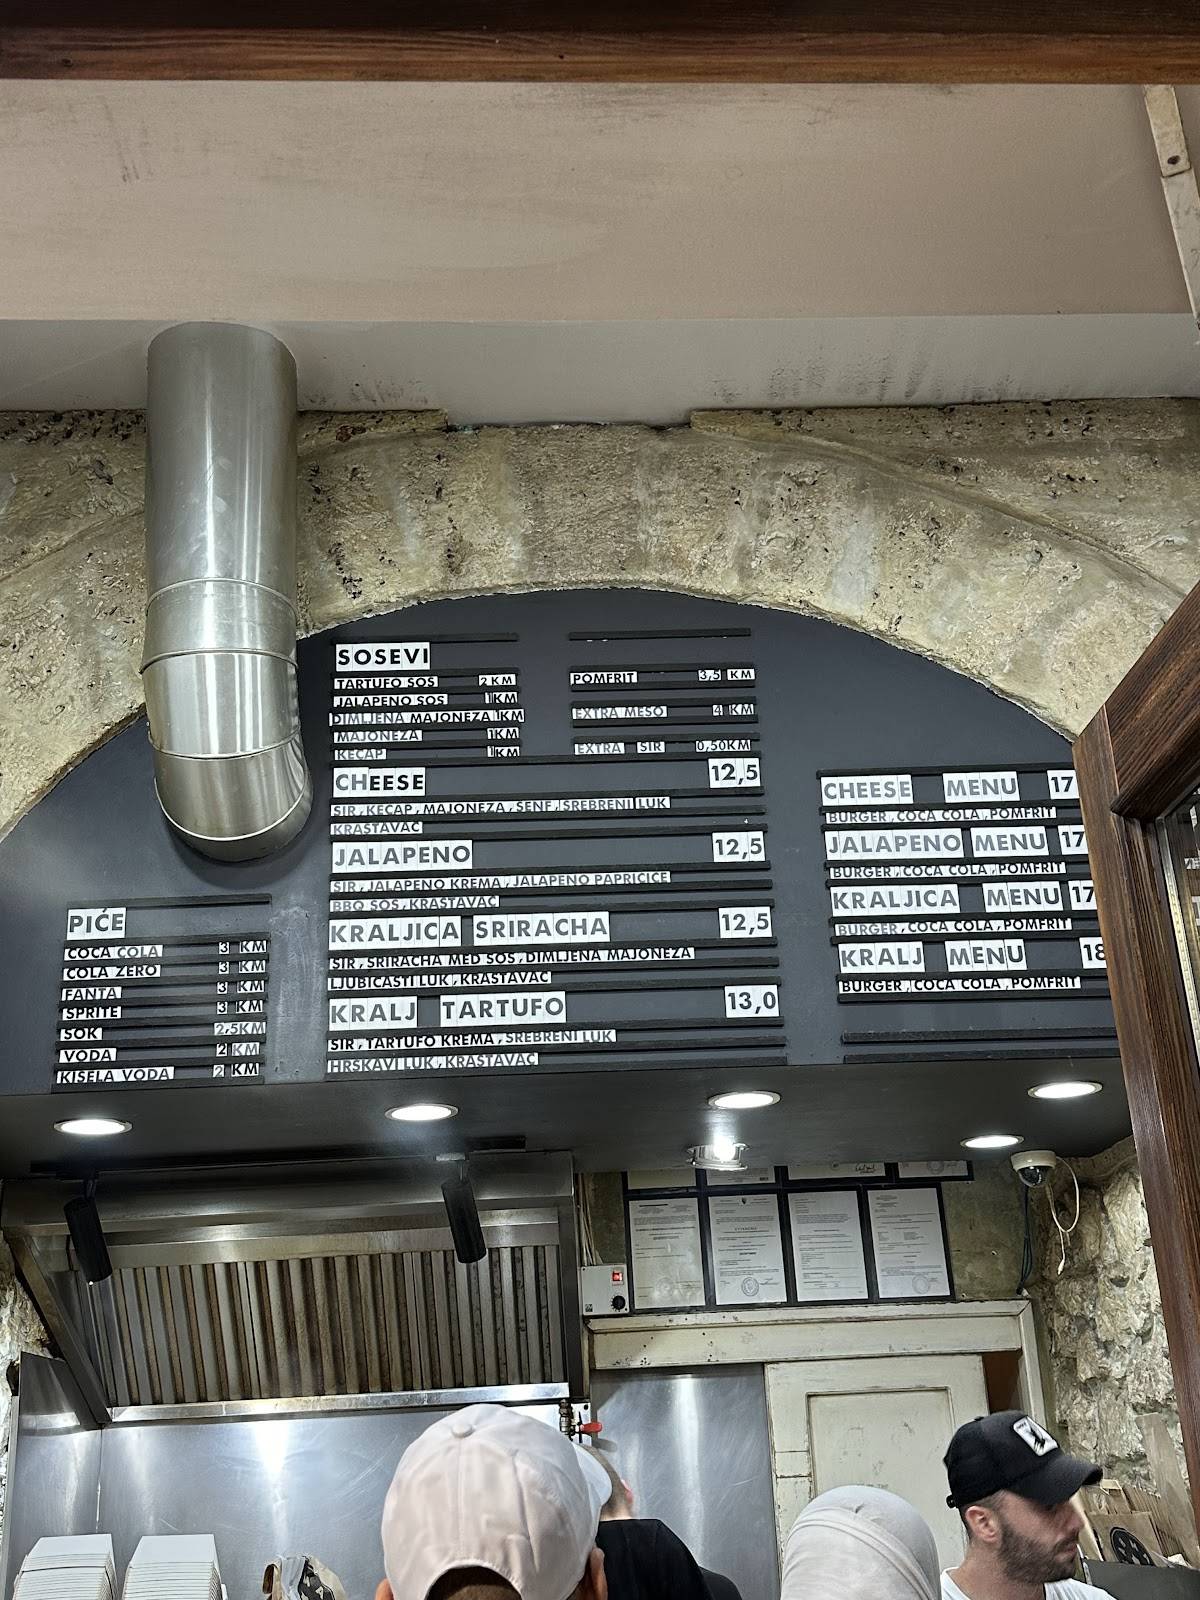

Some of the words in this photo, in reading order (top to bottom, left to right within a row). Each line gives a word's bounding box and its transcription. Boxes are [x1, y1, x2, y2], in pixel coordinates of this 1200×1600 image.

[337, 648, 429, 665] SOSEVI
[337, 678, 402, 689] TARTUFO
[407, 677, 435, 688] SOS
[573, 672, 635, 684] POMFRIT
[699, 669, 721, 681] 3,5
[730, 670, 752, 679] KM
[336, 696, 412, 707] JALAPENO
[416, 695, 445, 705] SOS
[332, 713, 405, 725] DIMLJENA
[410, 711, 491, 724] MAJONEZA
[575, 708, 619, 719] EXTRA
[624, 706, 664, 717] MESO
[730, 704, 753, 715] KM
[337, 731, 419, 742] MAJONEZA
[337, 749, 383, 760] KECAP
[577, 744, 621, 754] EXTRA
[640, 742, 662, 752] SIR
[335, 773, 424, 791] CHEESE
[711, 763, 758, 785] 12,5
[824, 780, 912, 799] CHEESE
[947, 777, 1017, 797] MENU
[563, 799, 633, 811] SREBRENI
[638, 797, 667, 809] LUK
[897, 809, 936, 821] COCA
[990, 806, 1053, 819] POMFRIT
[333, 822, 420, 835] KRASTAVAC
[715, 837, 763, 860] 12,5
[828, 834, 961, 853] JALAPENO
[974, 832, 1045, 851] MENU
[334, 845, 471, 867] JALAPENO
[903, 865, 943, 876] COCA
[999, 861, 1063, 874] POMFRIT
[368, 879, 445, 892] JALAPENO
[512, 873, 590, 887] JALAPENO
[594, 871, 668, 885] PAPRICICE
[333, 900, 365, 912] BBQ
[409, 896, 497, 909] KRASTAVAC
[833, 889, 958, 909] KRALJICA
[987, 887, 1060, 906] MENU
[69, 907, 124, 934] PIĆE
[721, 912, 769, 935] 12,5
[908, 921, 949, 933] COCA
[1003, 918, 1068, 930] POMFRIT
[331, 922, 459, 943] KRALJICA
[475, 917, 608, 939] SRIRACHA
[68, 948, 111, 959] COCA
[117, 946, 158, 958] COLA
[220, 942, 228, 953] 3
[240, 941, 265, 952] KM
[366, 955, 442, 968] SRIRACHA
[449, 954, 481, 965] MED
[526, 949, 601, 964] DIMLJENA
[606, 947, 691, 961] MAJONEZA
[841, 947, 923, 968] KRALJ
[949, 945, 1024, 965] MENU
[66, 967, 109, 979] COLA
[115, 965, 157, 977] ZERO
[220, 962, 228, 973] 3
[239, 960, 265, 972] KM
[330, 975, 415, 989] LJUBICASTI
[460, 971, 549, 986] KRASTAVAC
[914, 979, 955, 990] COCA
[1011, 976, 1077, 989] POMFRIT
[65, 987, 117, 1000] FANTA
[218, 982, 226, 993] 3
[237, 980, 263, 992] KM
[66, 1007, 118, 1019] SPRITE
[218, 1002, 226, 1013] 3
[236, 1001, 262, 1012] KM
[331, 1002, 416, 1024] KRALJ
[442, 997, 564, 1020] TARTUFO
[728, 991, 776, 1014] 13,0
[64, 1028, 98, 1040] SOK
[366, 1035, 436, 1049] TARTUFO
[505, 1031, 579, 1043] SREBRENI
[582, 1030, 613, 1042] LUK
[64, 1049, 112, 1062] VODA
[218, 1044, 226, 1055] 2
[232, 1043, 258, 1055] KM
[330, 1058, 399, 1073] HRSKAVI
[446, 1053, 536, 1068] KRASTAVAC
[60, 1070, 115, 1083] KISELA
[122, 1067, 169, 1081] VODA
[215, 1065, 223, 1076] 2
[232, 1063, 258, 1075] KM
